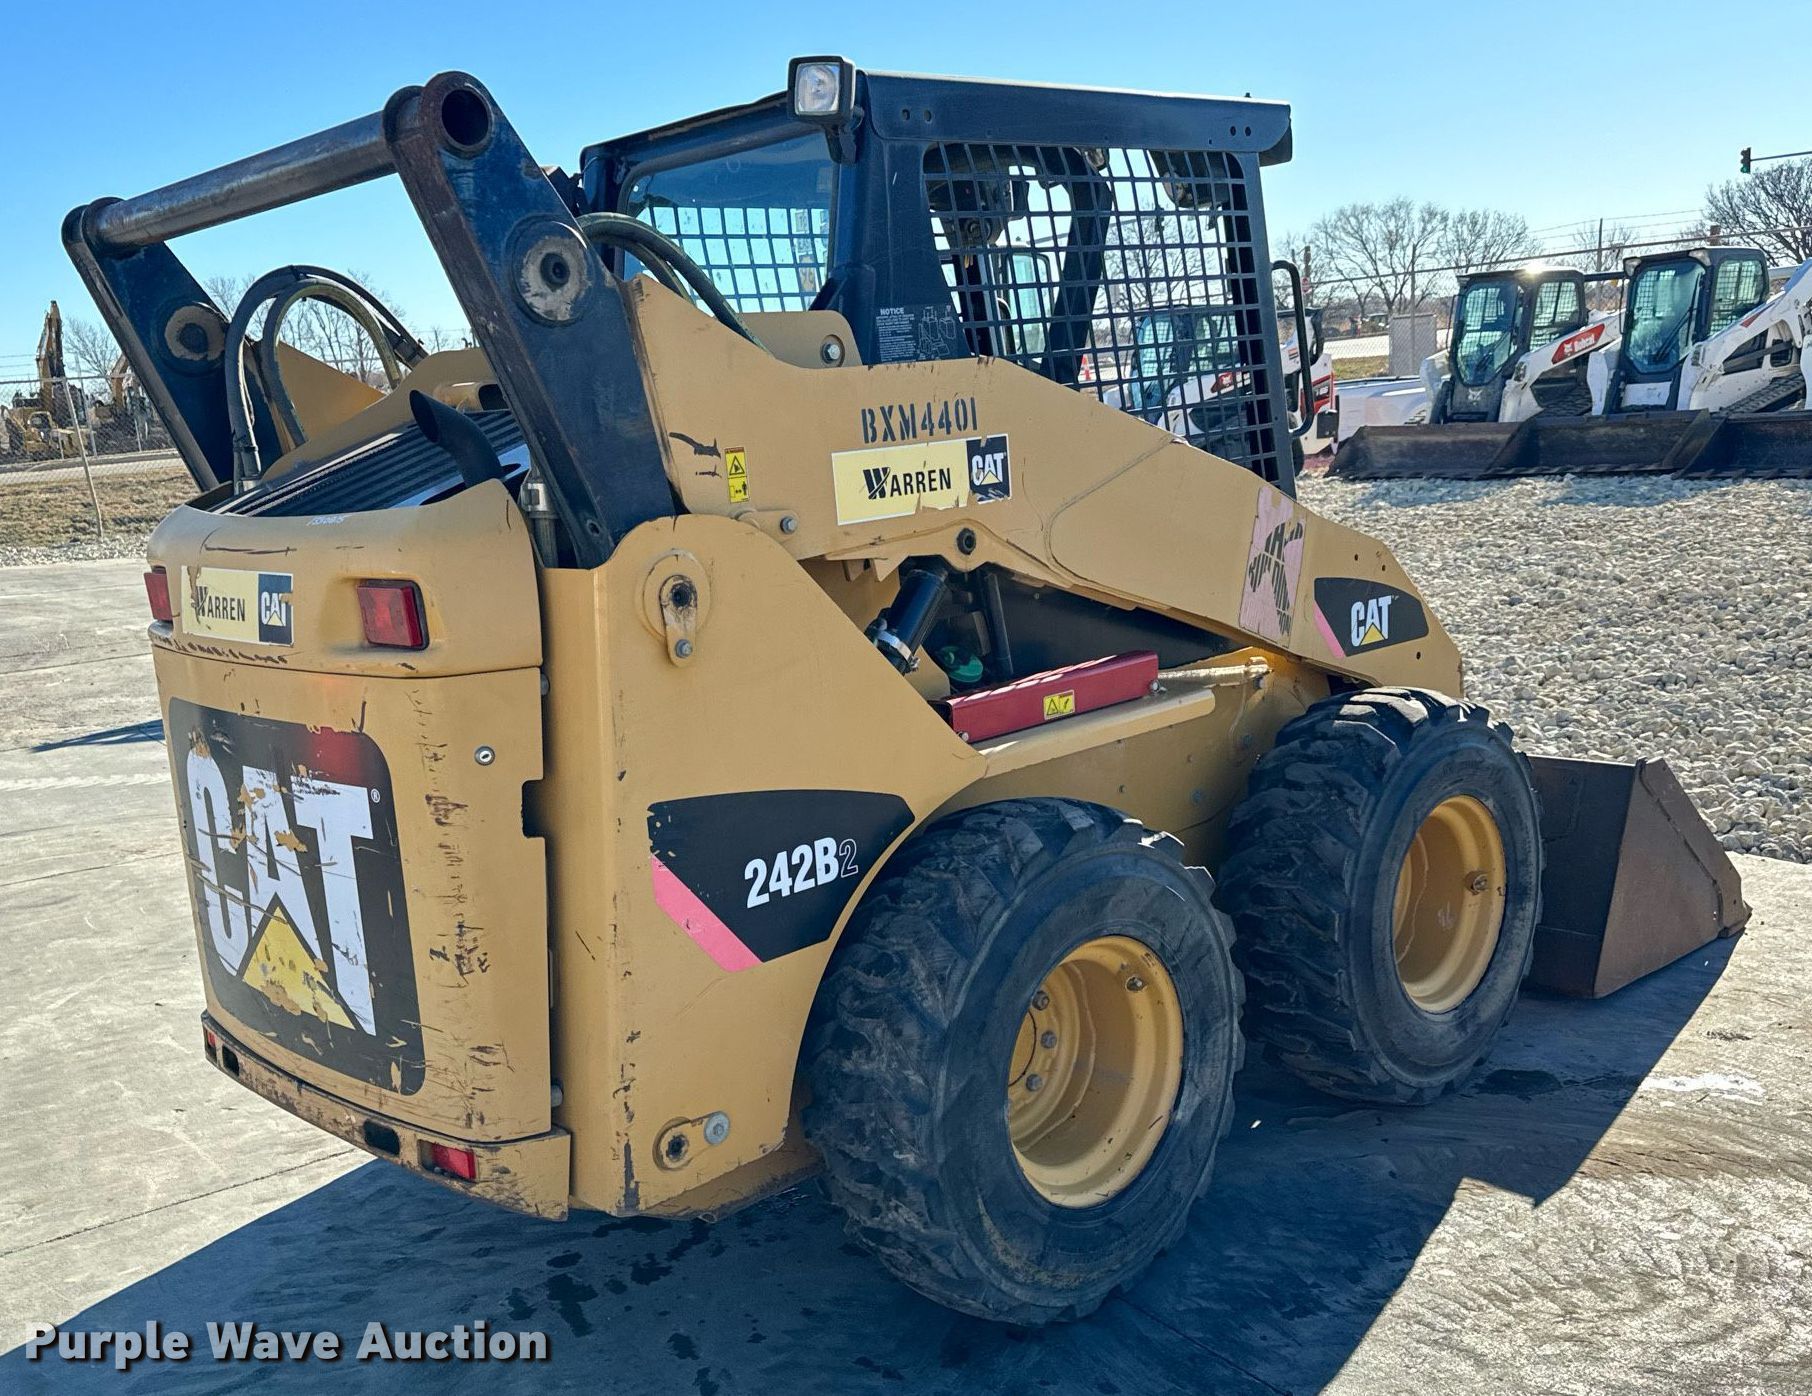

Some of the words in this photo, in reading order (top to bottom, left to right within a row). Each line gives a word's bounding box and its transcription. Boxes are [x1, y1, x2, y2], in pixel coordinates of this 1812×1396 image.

[880, 307, 905, 316] NOTICE
[862, 466, 952, 500] WARREN
[971, 452, 1004, 486] CAT
[194, 585, 246, 622] WARREN
[1350, 595, 1392, 647] CAT
[186, 749, 376, 1037] CAT
